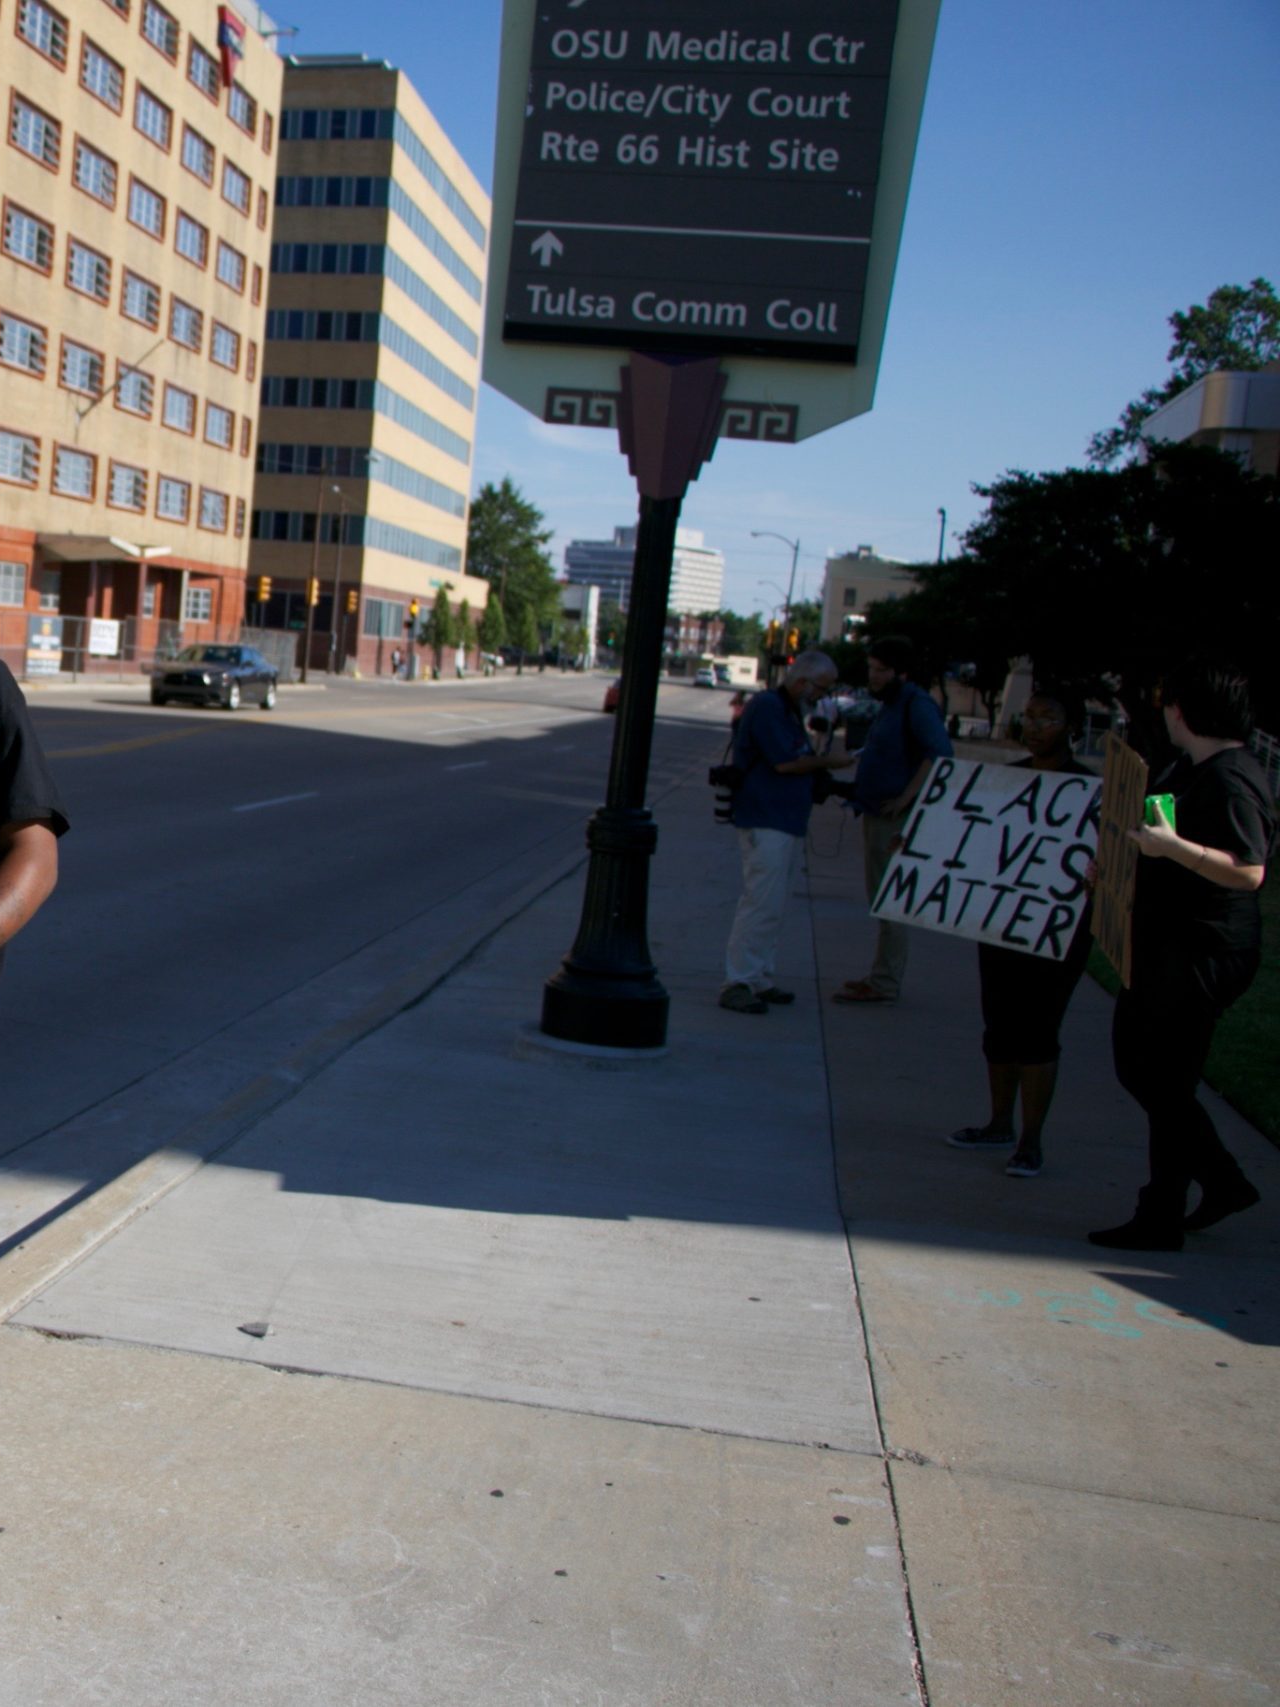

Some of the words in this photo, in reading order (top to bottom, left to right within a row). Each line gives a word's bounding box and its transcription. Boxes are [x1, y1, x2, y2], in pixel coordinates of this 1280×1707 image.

[551, 29, 629, 60] OSU
[646, 31, 791, 63] Medical
[808, 34, 864, 64] Ctr
[545, 81, 731, 122] Police/City
[747, 87, 851, 119] Court
[540, 132, 599, 162] Rte
[616, 135, 659, 164] 66
[677, 136, 750, 168] Hist
[768, 139, 839, 171] Site
[526, 285, 615, 319] Tulsa
[631, 292, 747, 327] Comm
[766, 300, 838, 333] Coll
[924, 759, 1103, 839] BLACK
[901, 809, 1096, 901] LIVES
[873, 864, 1076, 959] MATTER
